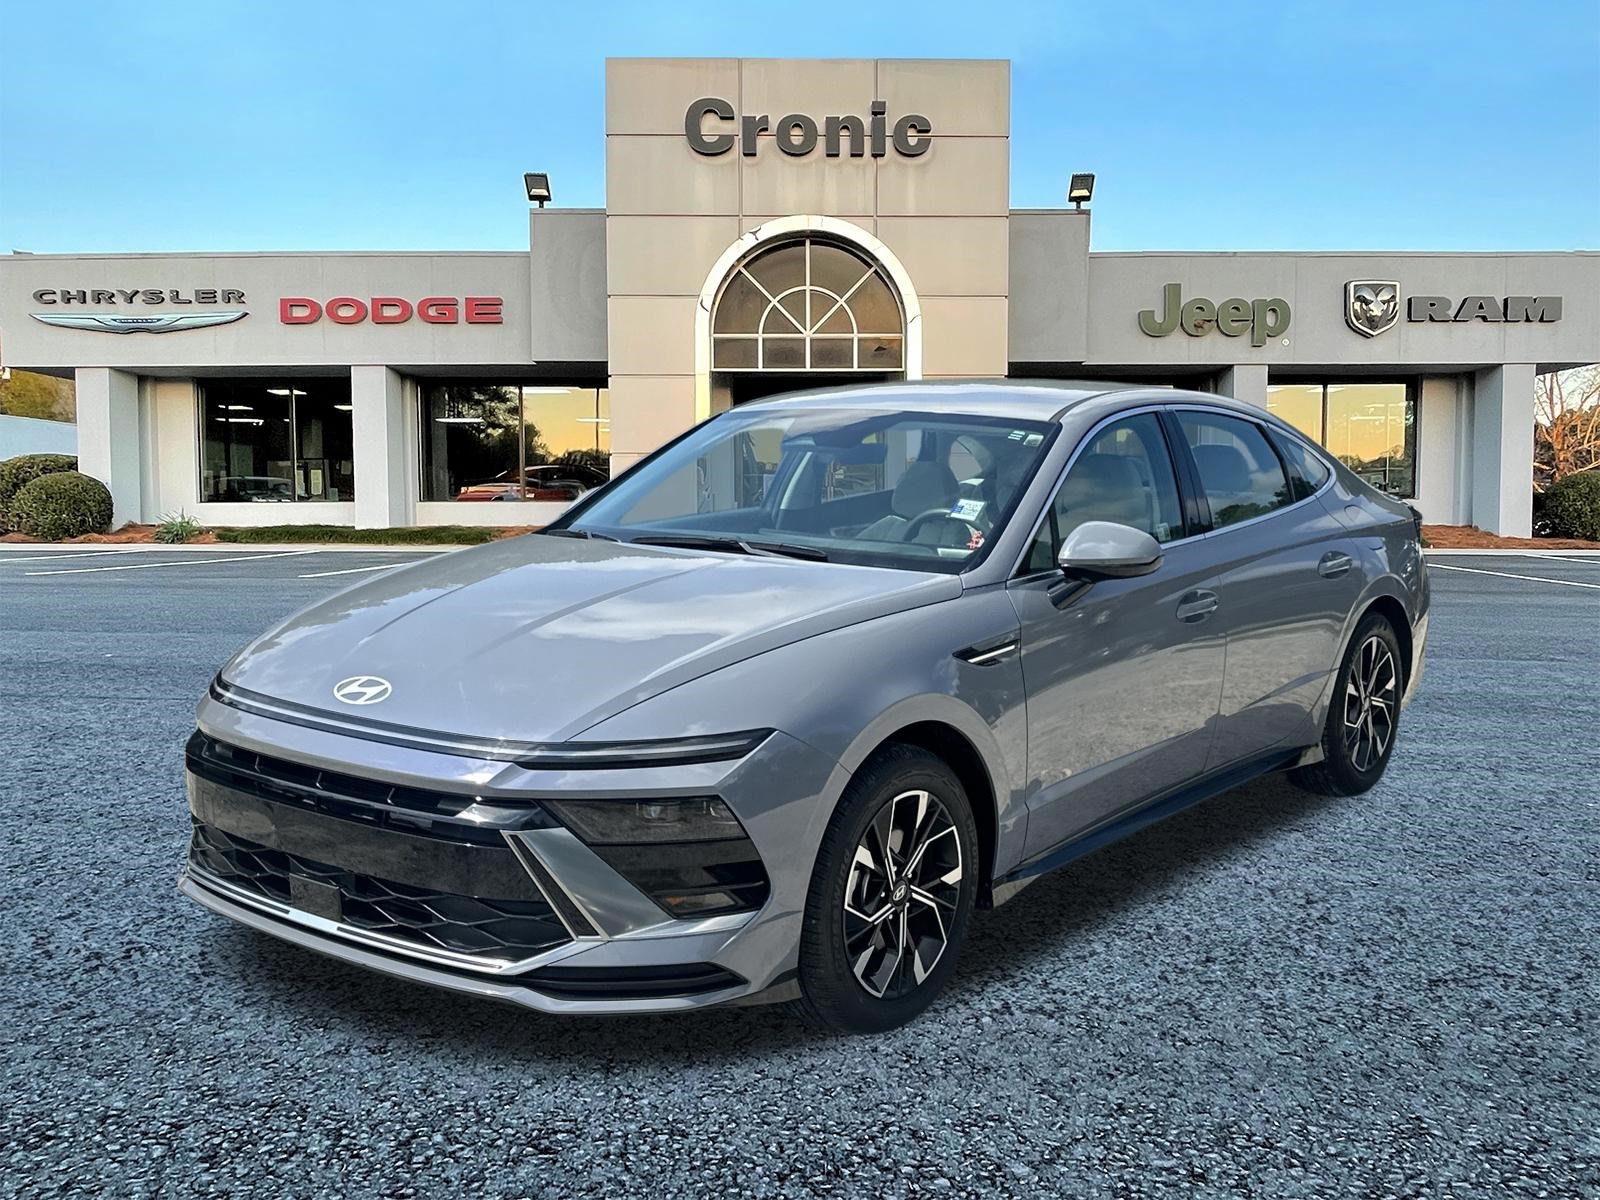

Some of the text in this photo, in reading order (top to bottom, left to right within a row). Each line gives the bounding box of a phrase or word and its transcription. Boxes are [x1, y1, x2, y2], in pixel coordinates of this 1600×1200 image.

[685, 97, 932, 158] Cronic
[33, 288, 247, 305] CHRYSLER
[1407, 296, 1563, 322] RAM
[280, 297, 504, 325] DODGE
[1138, 283, 1291, 347] Jeep
